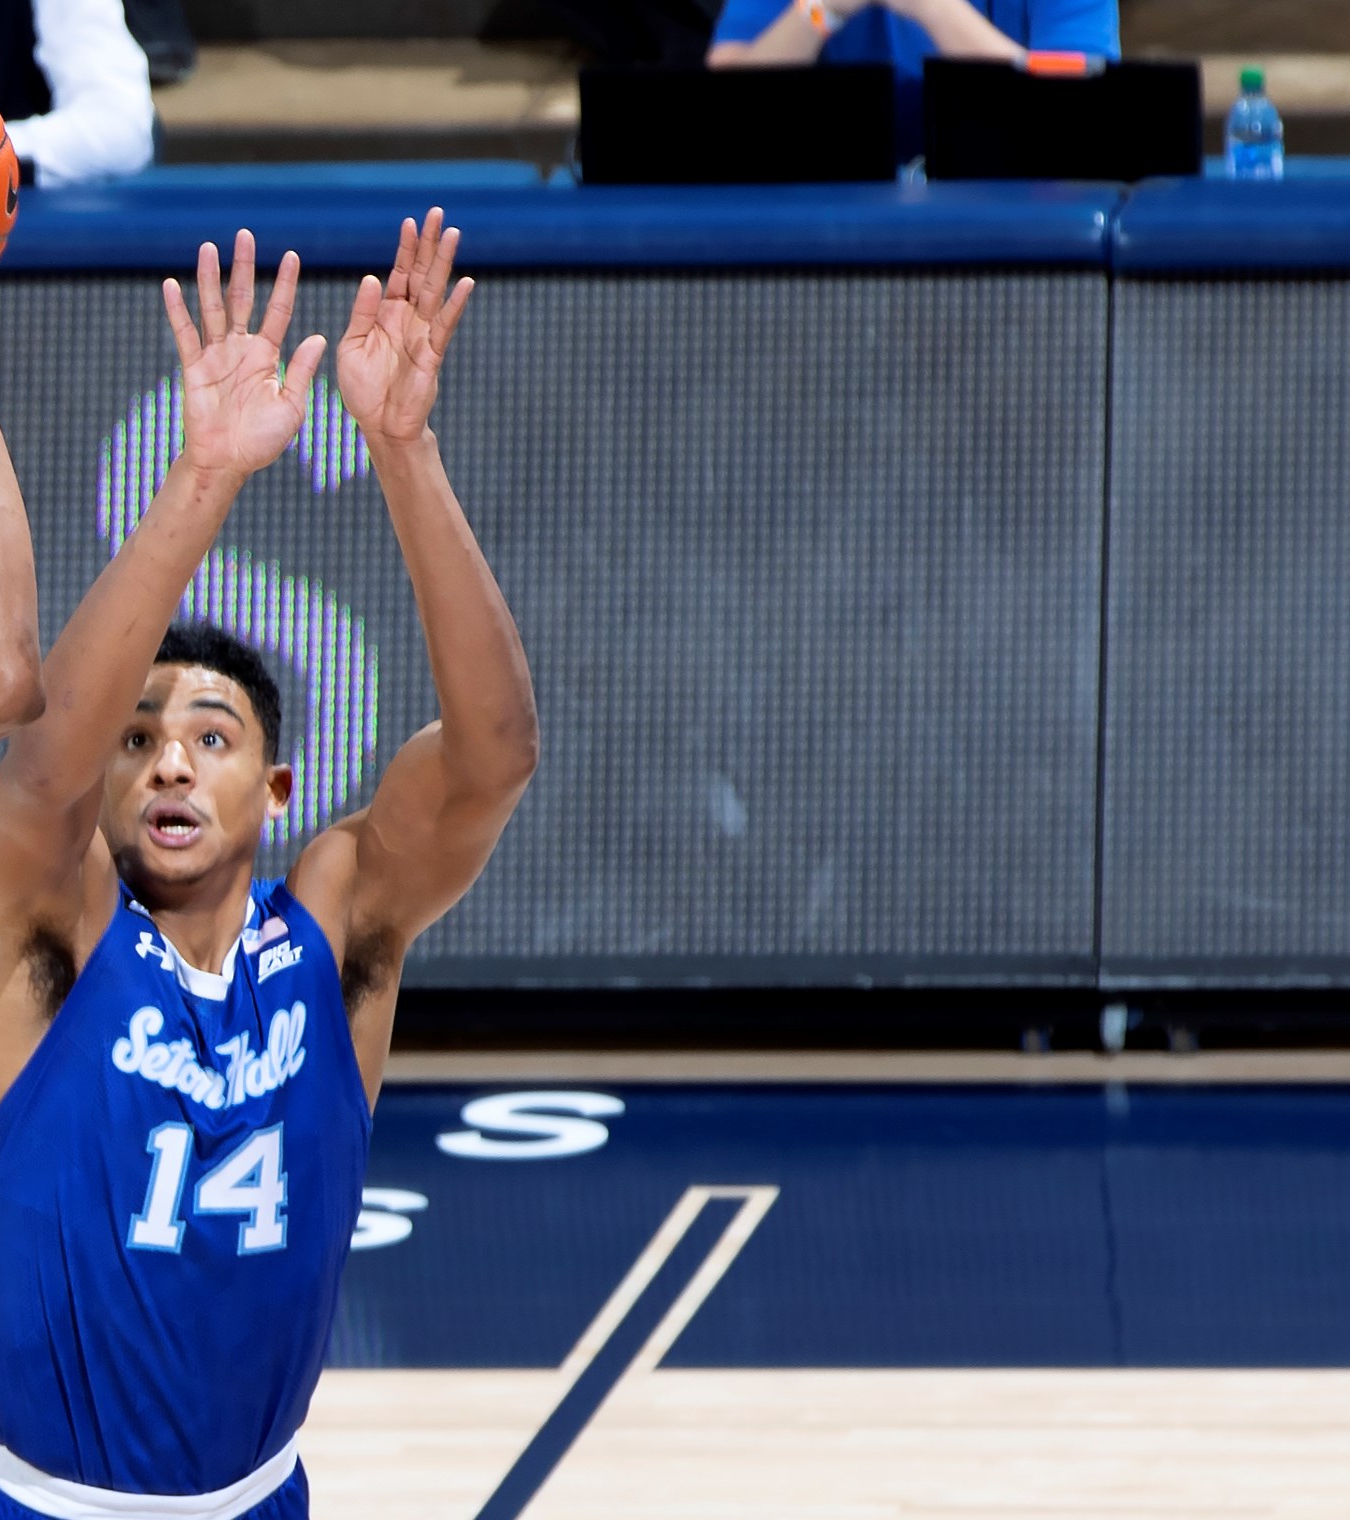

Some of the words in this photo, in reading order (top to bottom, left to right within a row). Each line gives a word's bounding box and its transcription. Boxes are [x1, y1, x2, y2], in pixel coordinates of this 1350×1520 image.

[112, 1006, 226, 1110] Seton
[215, 1000, 307, 1110] Hall
[126, 1120, 288, 1257] 14
